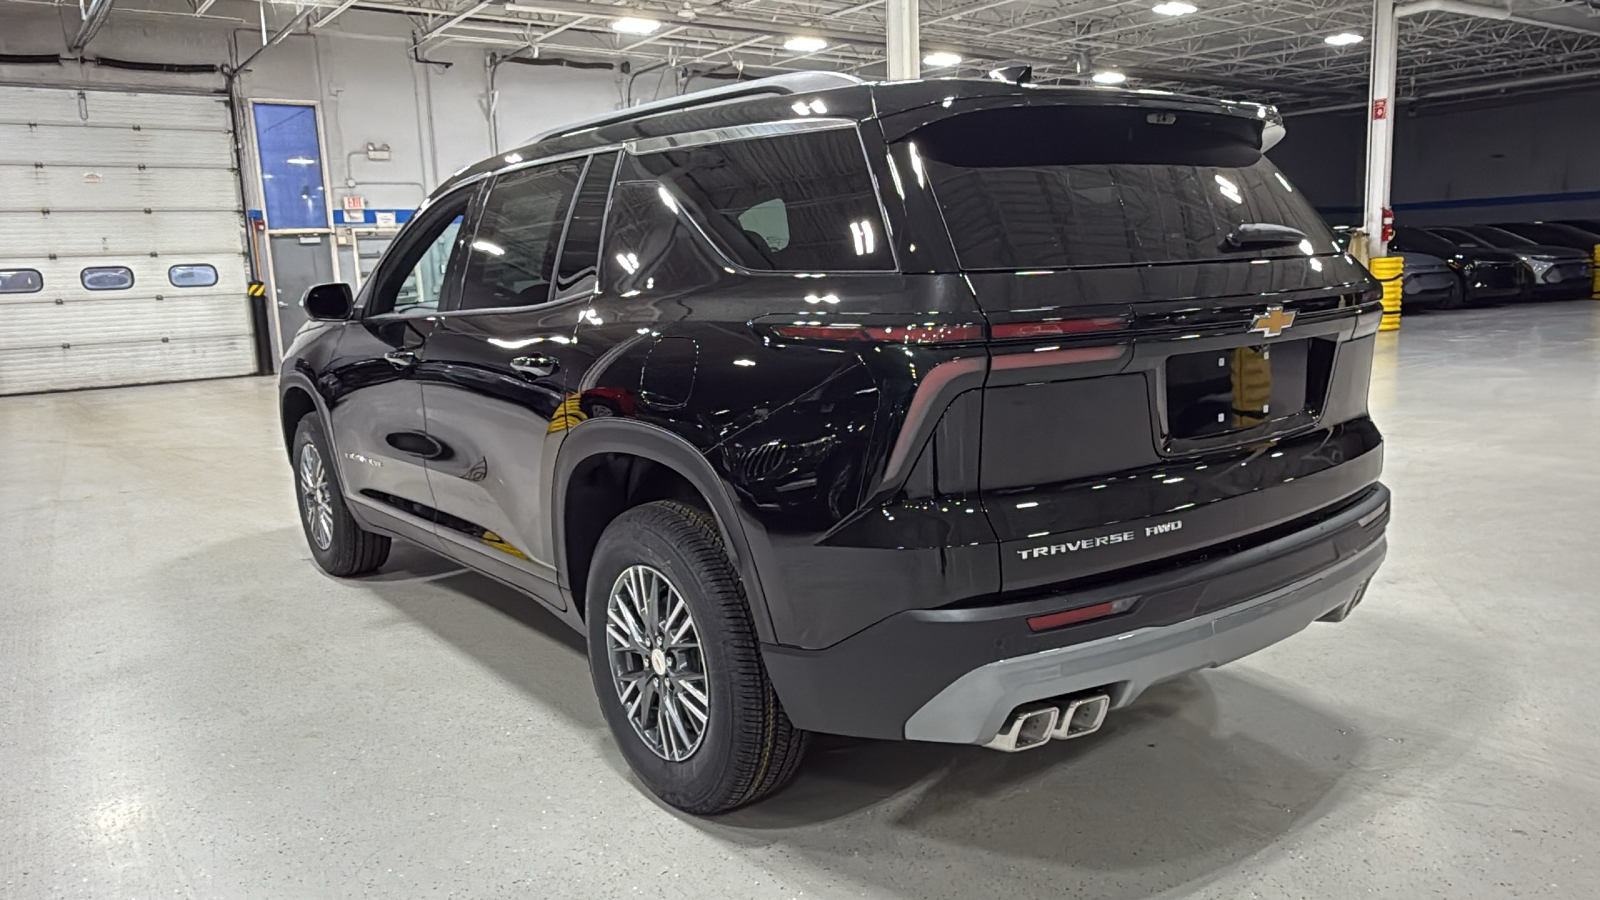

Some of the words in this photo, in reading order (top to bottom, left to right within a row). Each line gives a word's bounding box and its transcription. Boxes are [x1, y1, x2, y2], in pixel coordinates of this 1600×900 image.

[347, 196, 362, 208] EXIT
[1017, 531, 1135, 560] TRAVERSE
[1145, 520, 1183, 537] AWD
